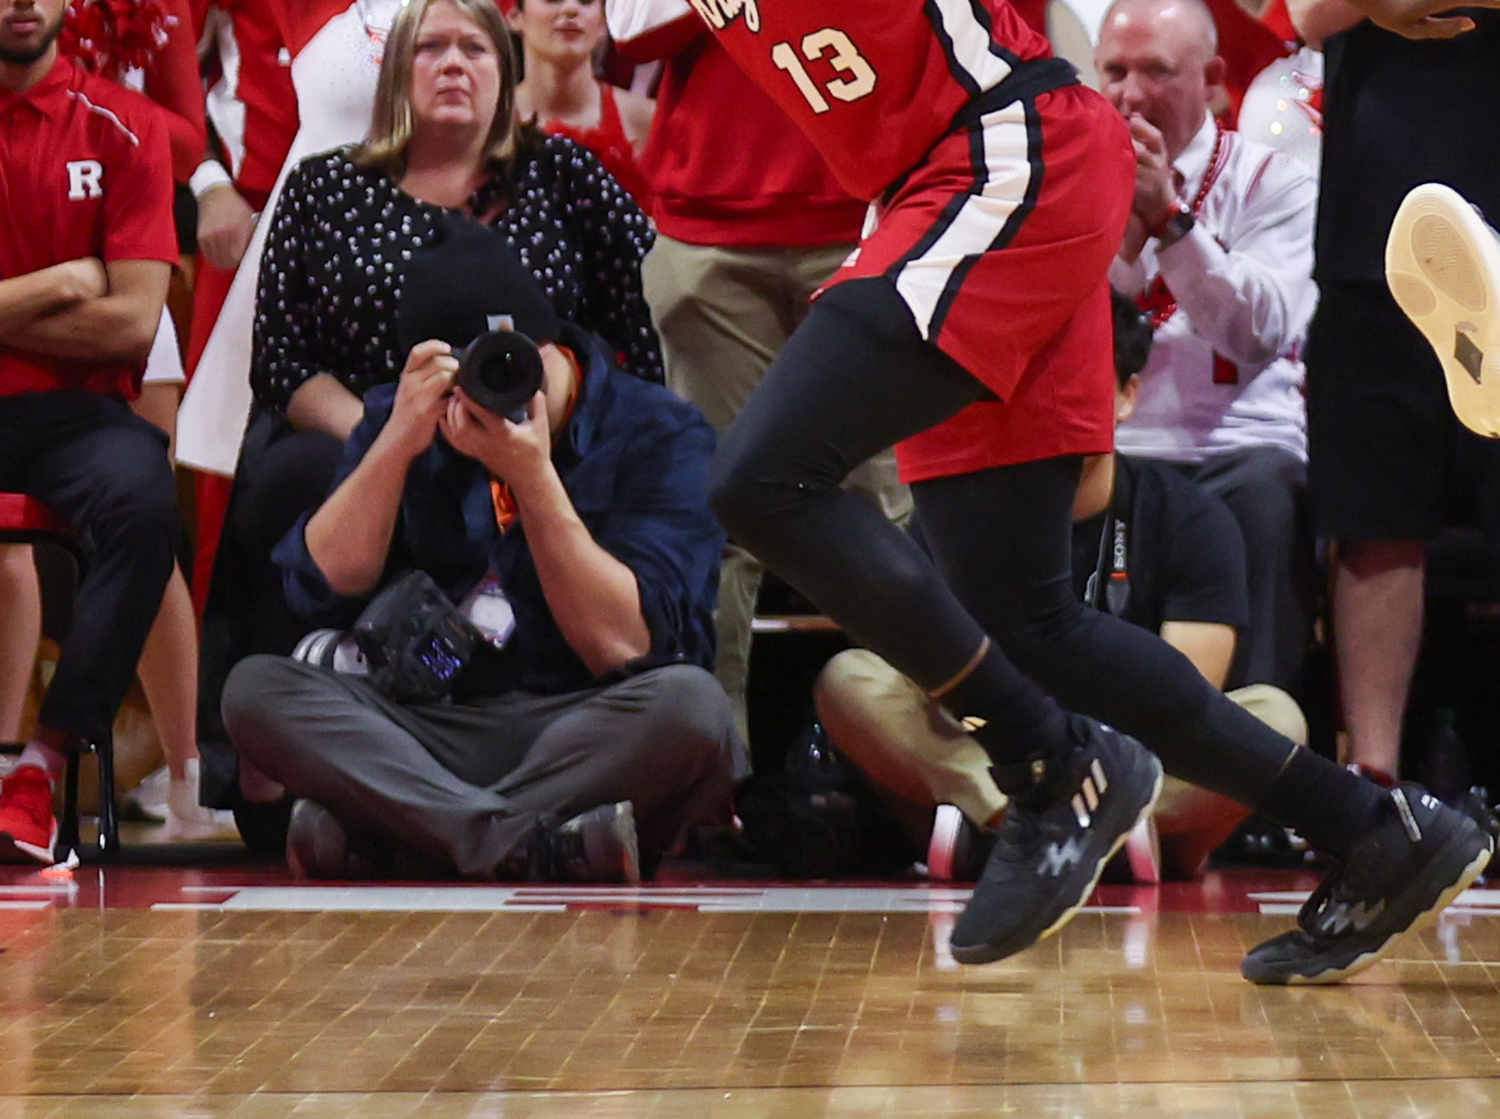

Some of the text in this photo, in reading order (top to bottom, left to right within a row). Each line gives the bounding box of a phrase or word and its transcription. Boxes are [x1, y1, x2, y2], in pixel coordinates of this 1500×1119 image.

[771, 27, 878, 115] 13
[66, 160, 103, 200] R
[1113, 519, 1126, 570] SONY
